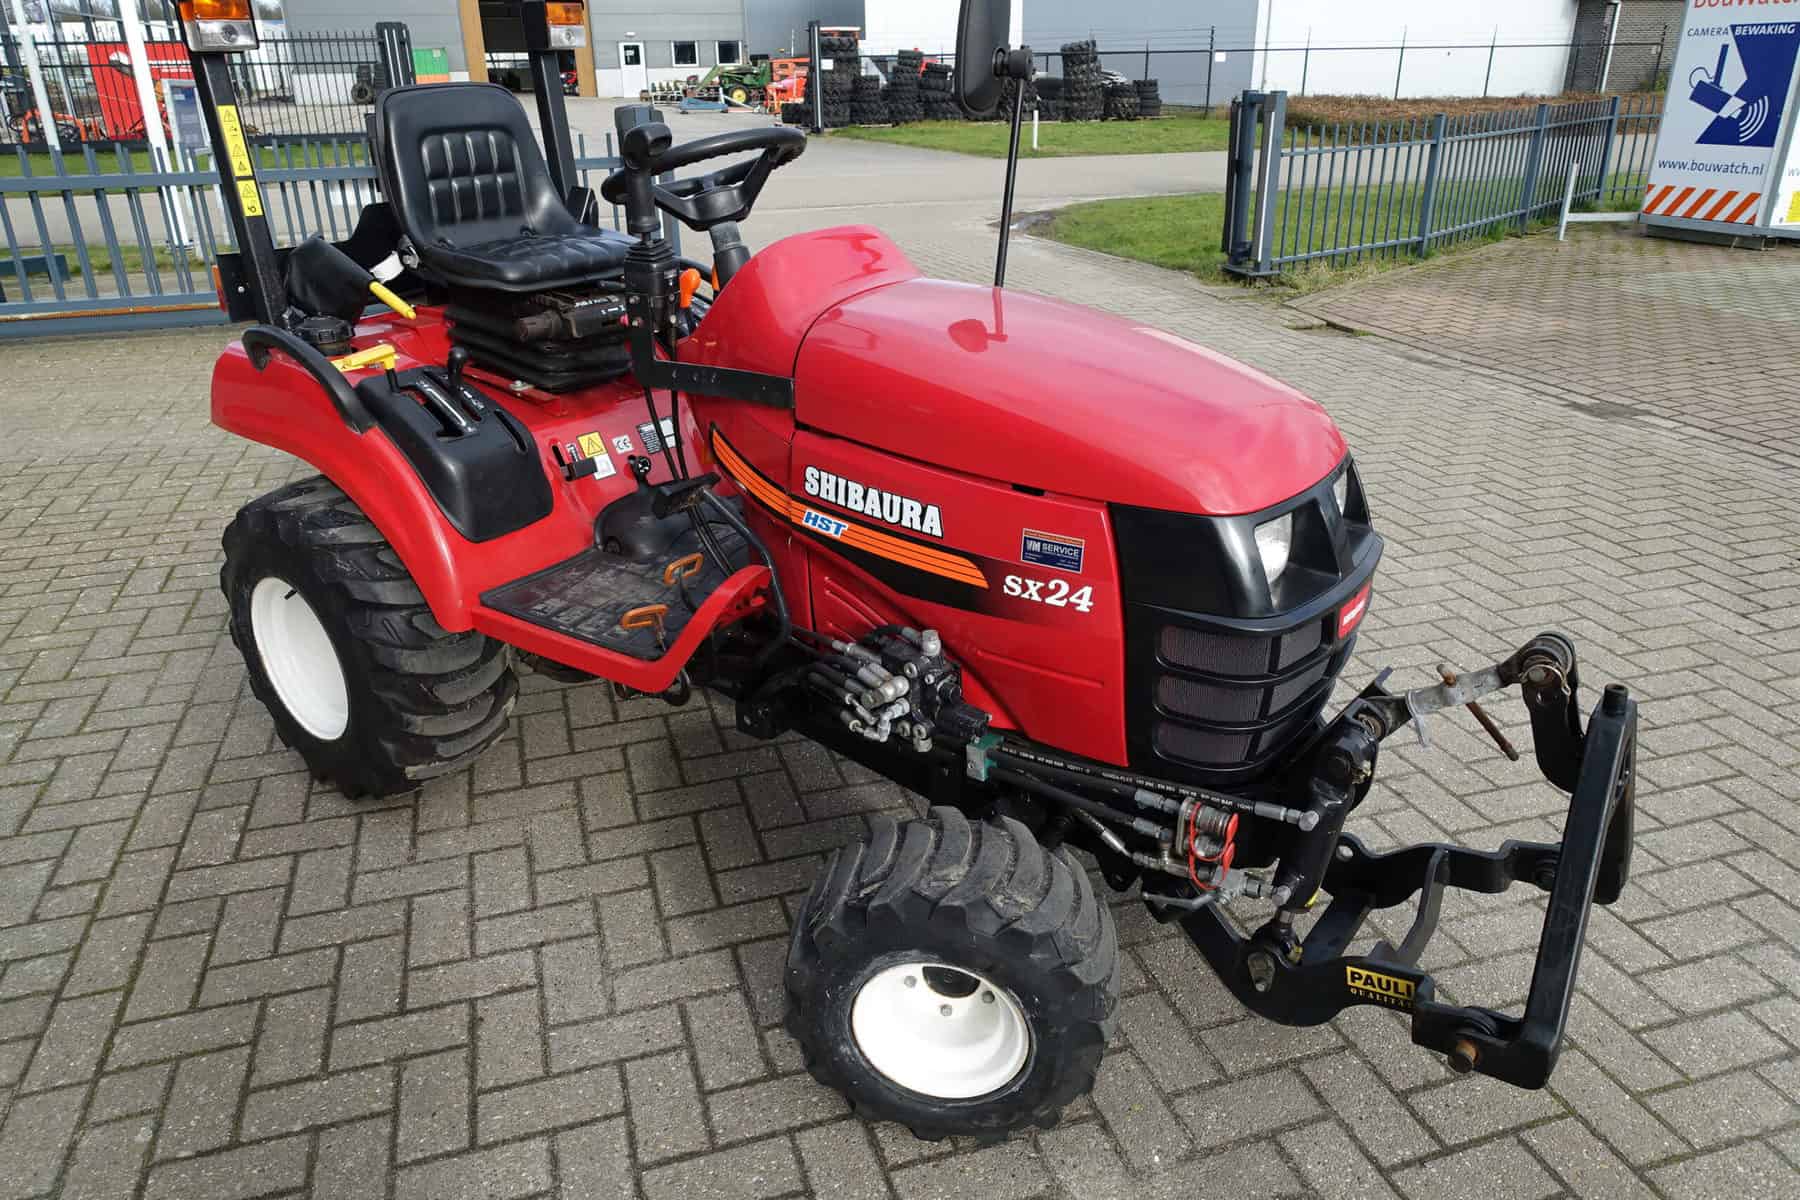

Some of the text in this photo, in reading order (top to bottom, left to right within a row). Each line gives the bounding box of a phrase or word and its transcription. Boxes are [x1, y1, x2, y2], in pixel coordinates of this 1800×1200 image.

[1687, 24, 1796, 36] CAMERA BEWAKING
[1658, 160, 1764, 175] www.bouwatch.nl
[804, 465, 944, 538] SHIBAURA
[803, 511, 847, 536] HST
[1042, 543, 1079, 557] SERVICE
[1003, 575, 1094, 612] SX24
[1350, 970, 1413, 996] PAULI
